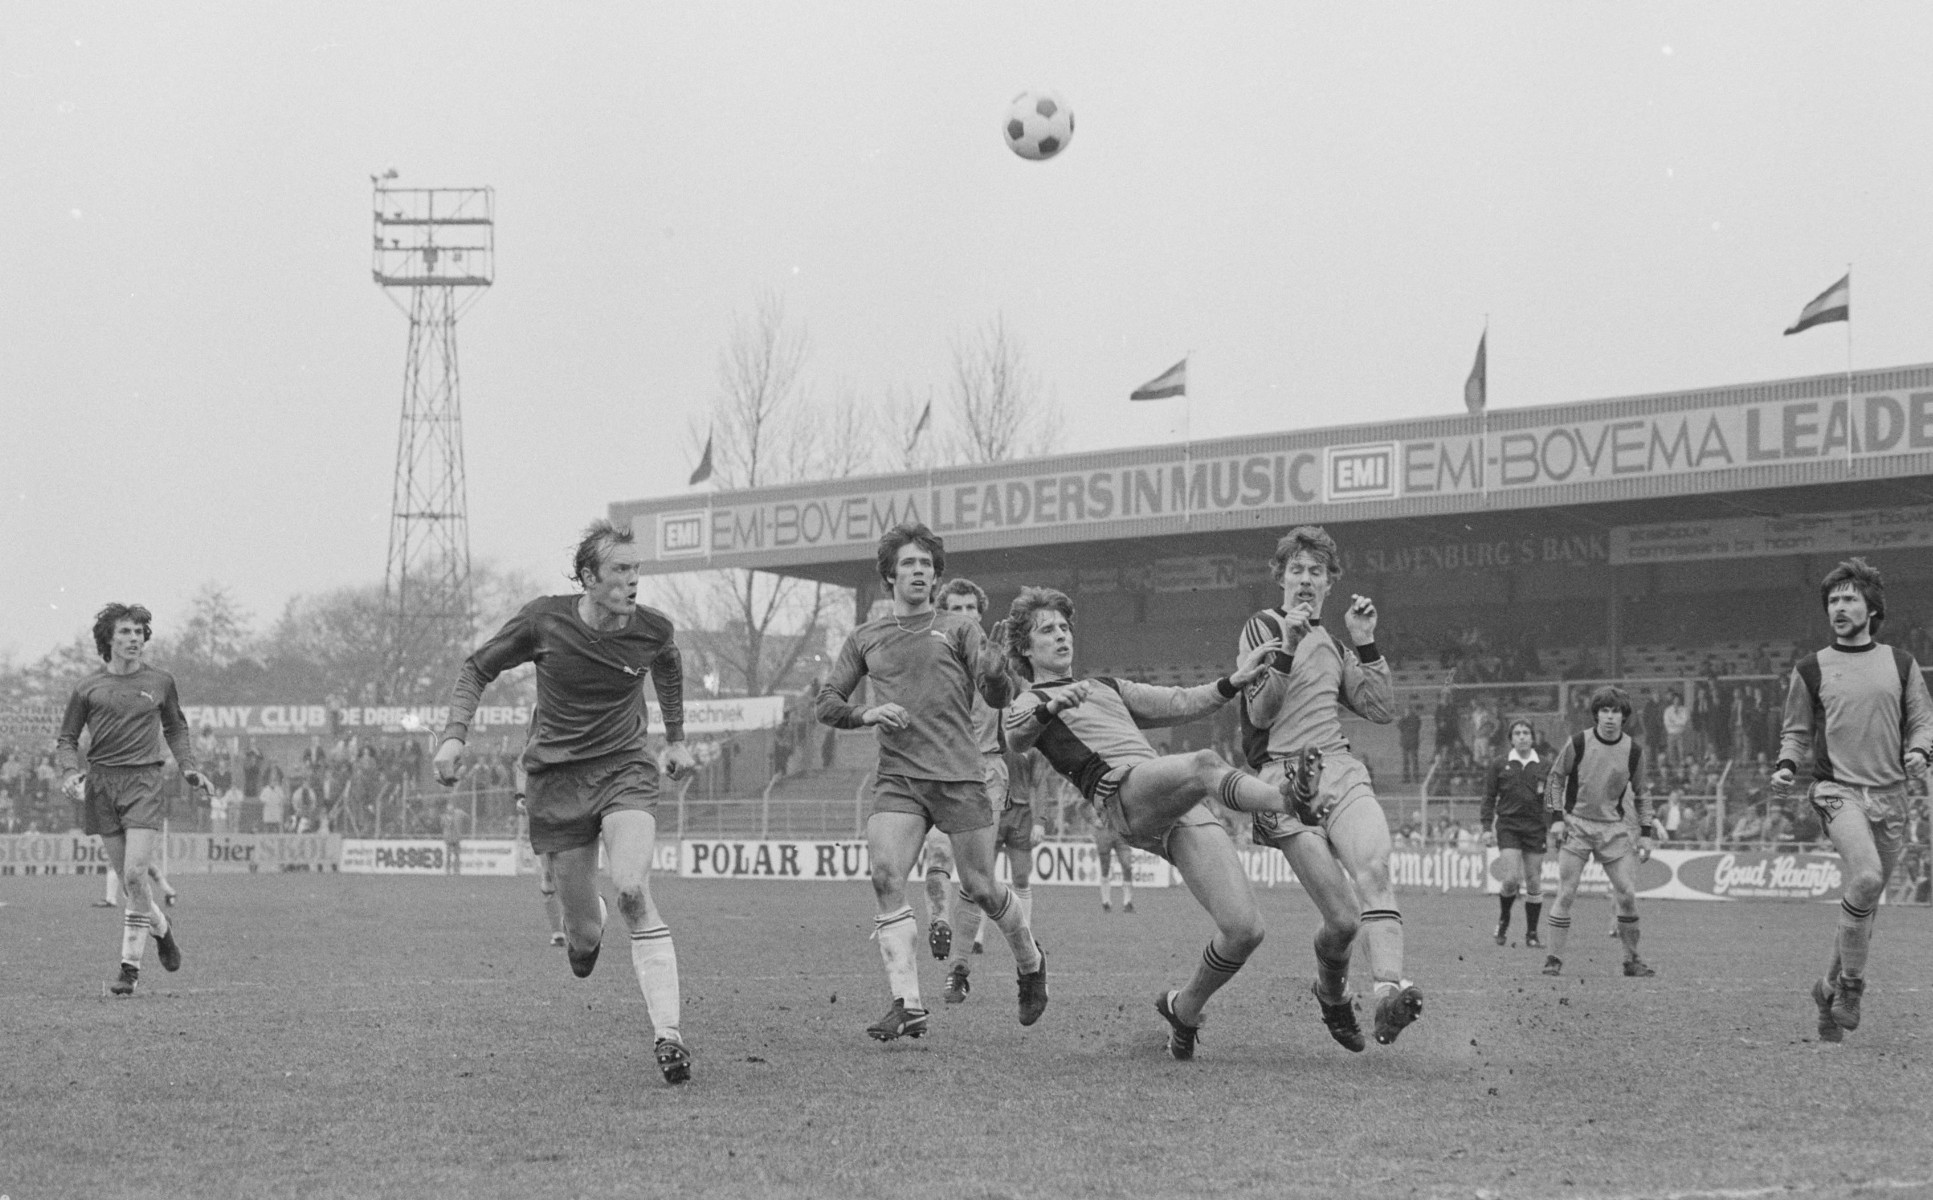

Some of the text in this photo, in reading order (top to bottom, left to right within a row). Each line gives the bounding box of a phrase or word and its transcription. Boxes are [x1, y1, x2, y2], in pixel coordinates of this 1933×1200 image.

[1404, 411, 1735, 494] EMI-BOVEMA
[1337, 456, 1385, 491] EMI
[711, 453, 1317, 552] EMI-BOVEMA LEADERS IN MUSIC
[669, 521, 699, 547] EMI
[1542, 535, 1606, 562] BANK
[183, 706, 327, 728] FANY CLUB
[364, 707, 407, 725] DRIE
[410, 706, 530, 725] MUSTIERS
[73, 838, 111, 862] bie
[208, 838, 255, 862] bier
[259, 838, 332, 862] SKOL
[691, 843, 802, 877] POLAR
[1713, 854, 1842, 896] Goud Haantje
